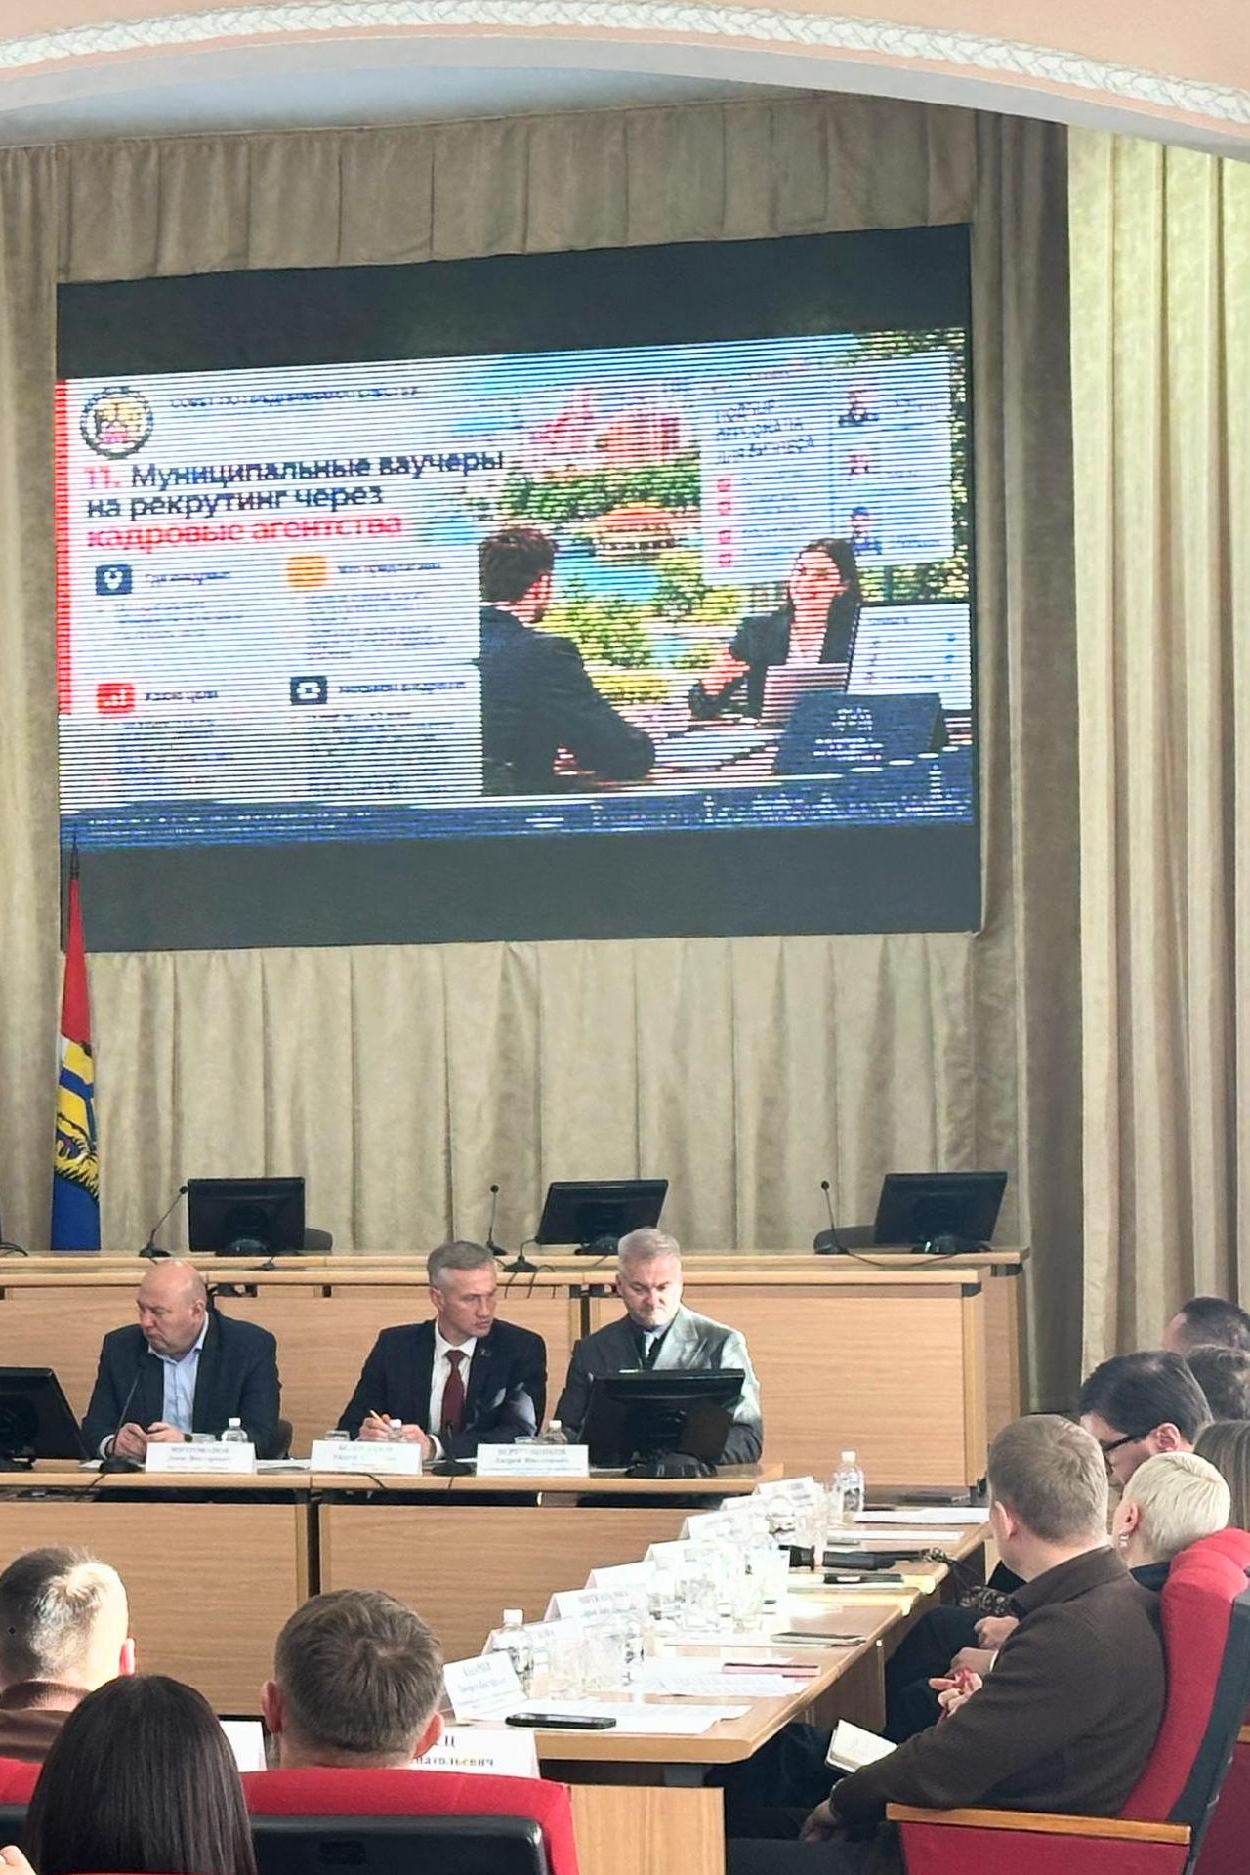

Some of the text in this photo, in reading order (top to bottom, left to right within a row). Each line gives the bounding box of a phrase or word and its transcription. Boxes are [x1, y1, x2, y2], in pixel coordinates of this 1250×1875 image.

[132, 457, 369, 491] Муниципальные
[380, 451, 503, 479] ваучеры
[88, 486, 383, 521] на рекрутинг через
[88, 516, 402, 554] кадровые агентства
